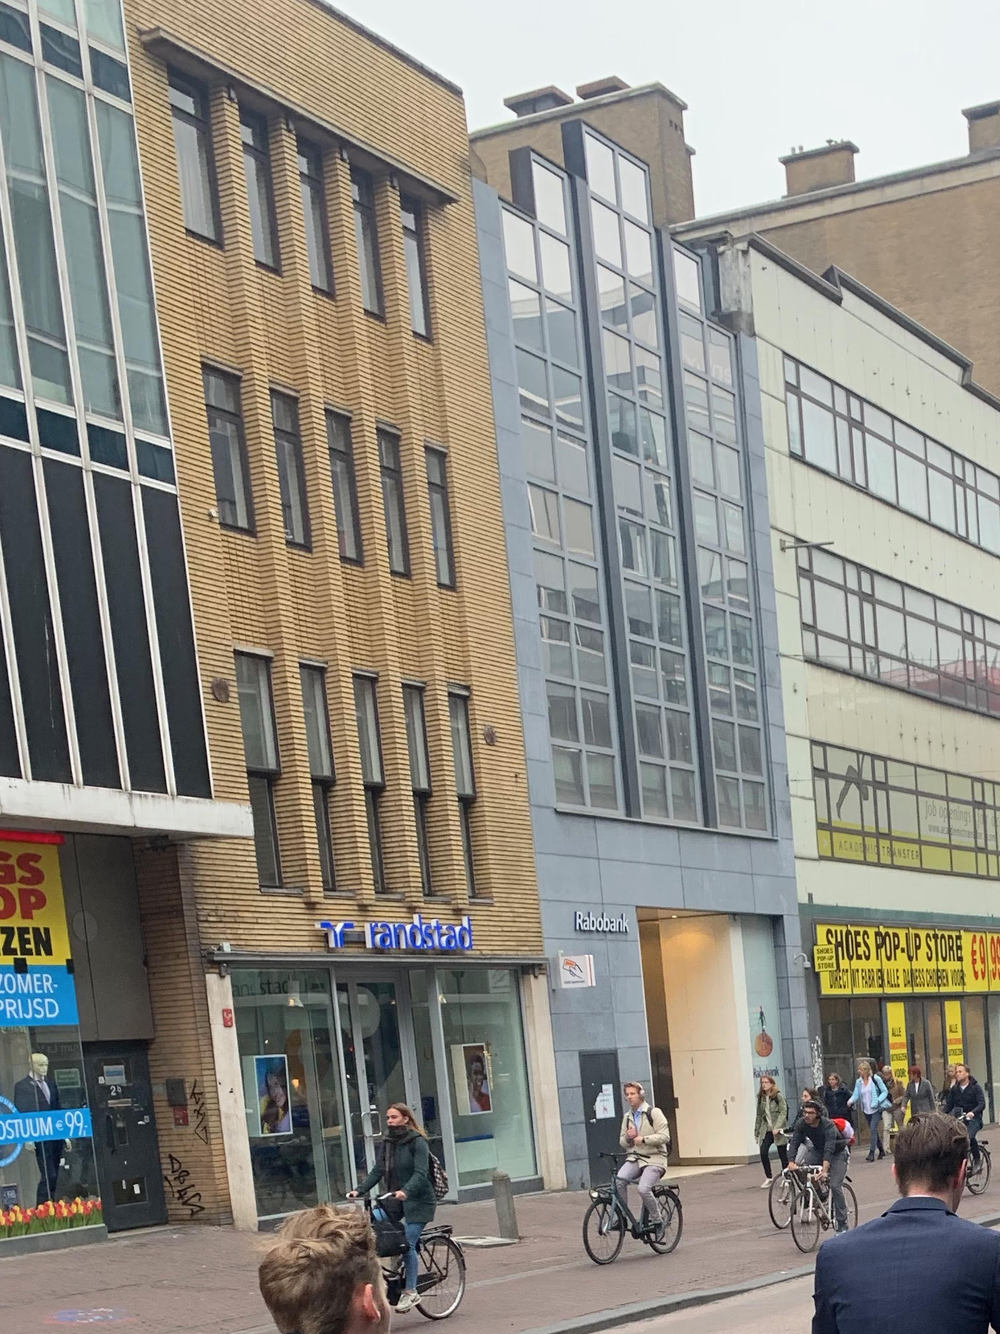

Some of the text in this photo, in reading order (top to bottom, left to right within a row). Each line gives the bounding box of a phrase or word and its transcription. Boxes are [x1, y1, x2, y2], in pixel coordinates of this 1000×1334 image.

[366, 914, 473, 950] randstad
[575, 912, 629, 933] Rabobank
[826, 928, 871, 961] SHOES
[874, 930, 921, 961] POP-UP
[926, 932, 963, 962] STORE
